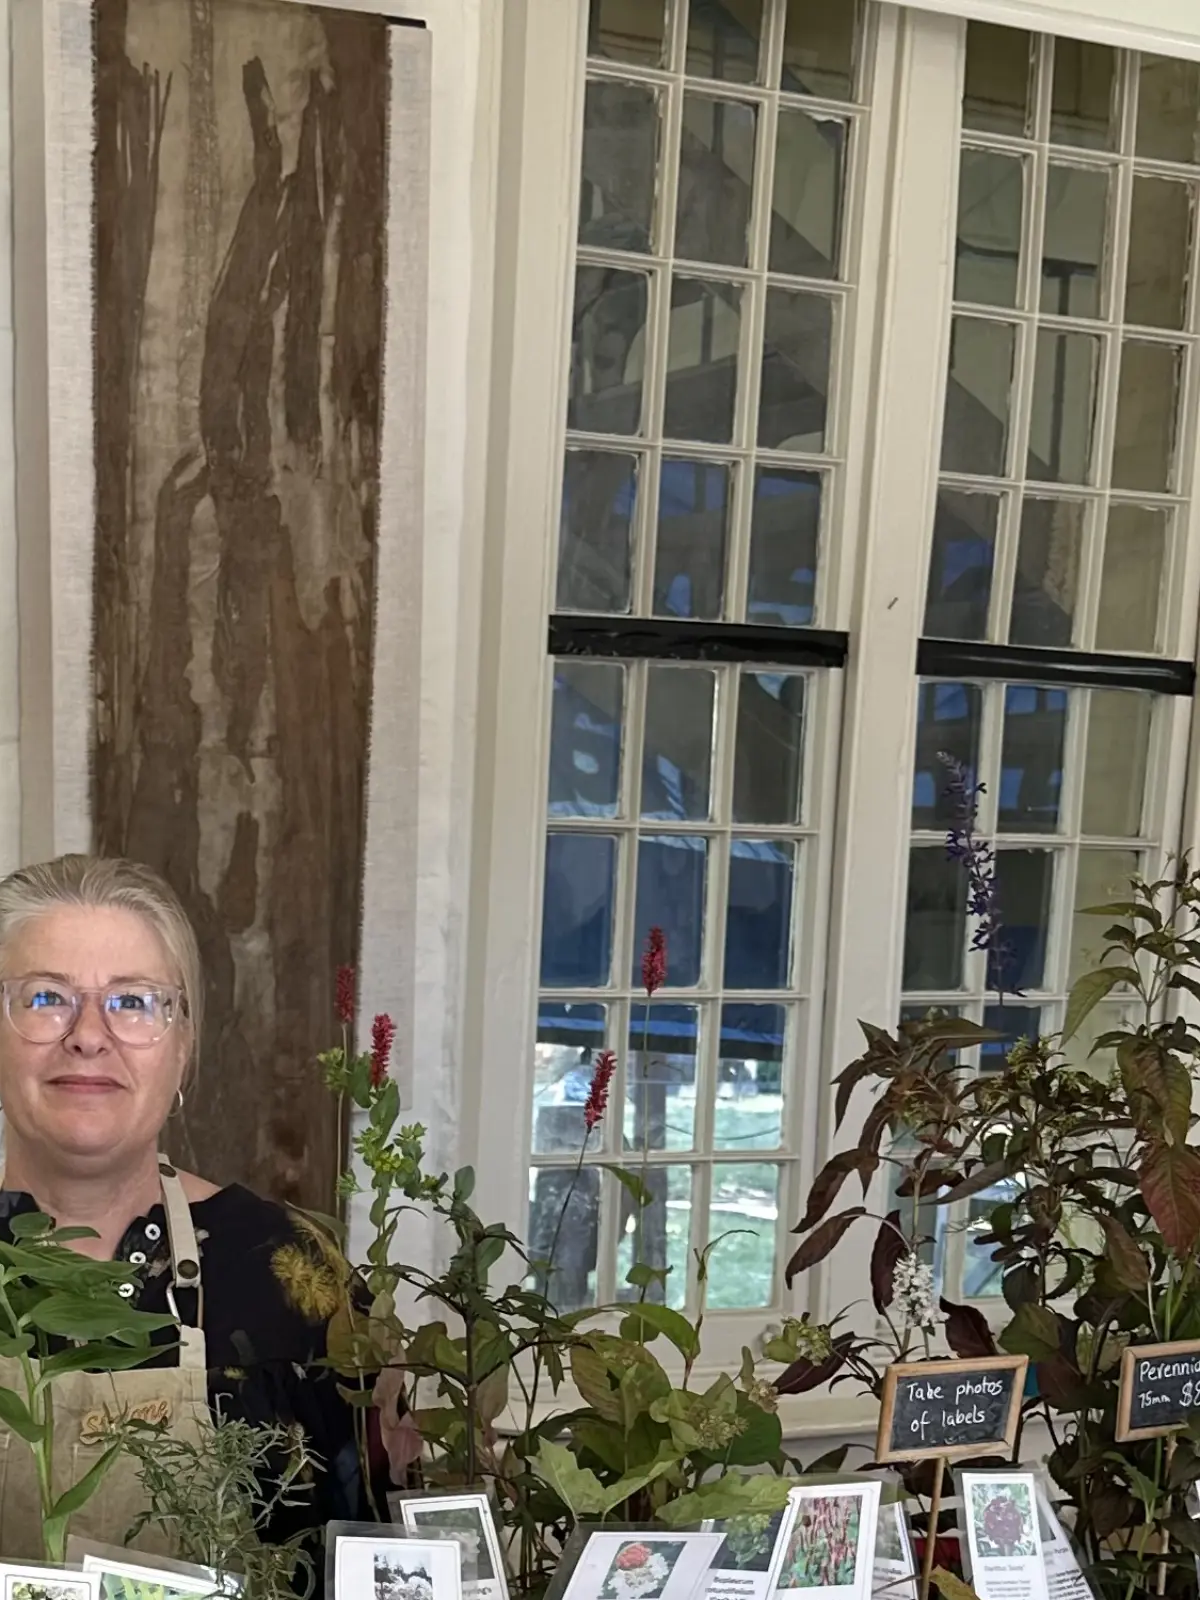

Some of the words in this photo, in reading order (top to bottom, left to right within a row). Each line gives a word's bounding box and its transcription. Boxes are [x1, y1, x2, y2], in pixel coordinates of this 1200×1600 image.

[1139, 1356, 1200, 1382] Perenni
[906, 1381, 944, 1401] Take
[955, 1376, 1003, 1405] photos
[910, 1411, 931, 1440] of
[941, 1405, 985, 1427] labels
